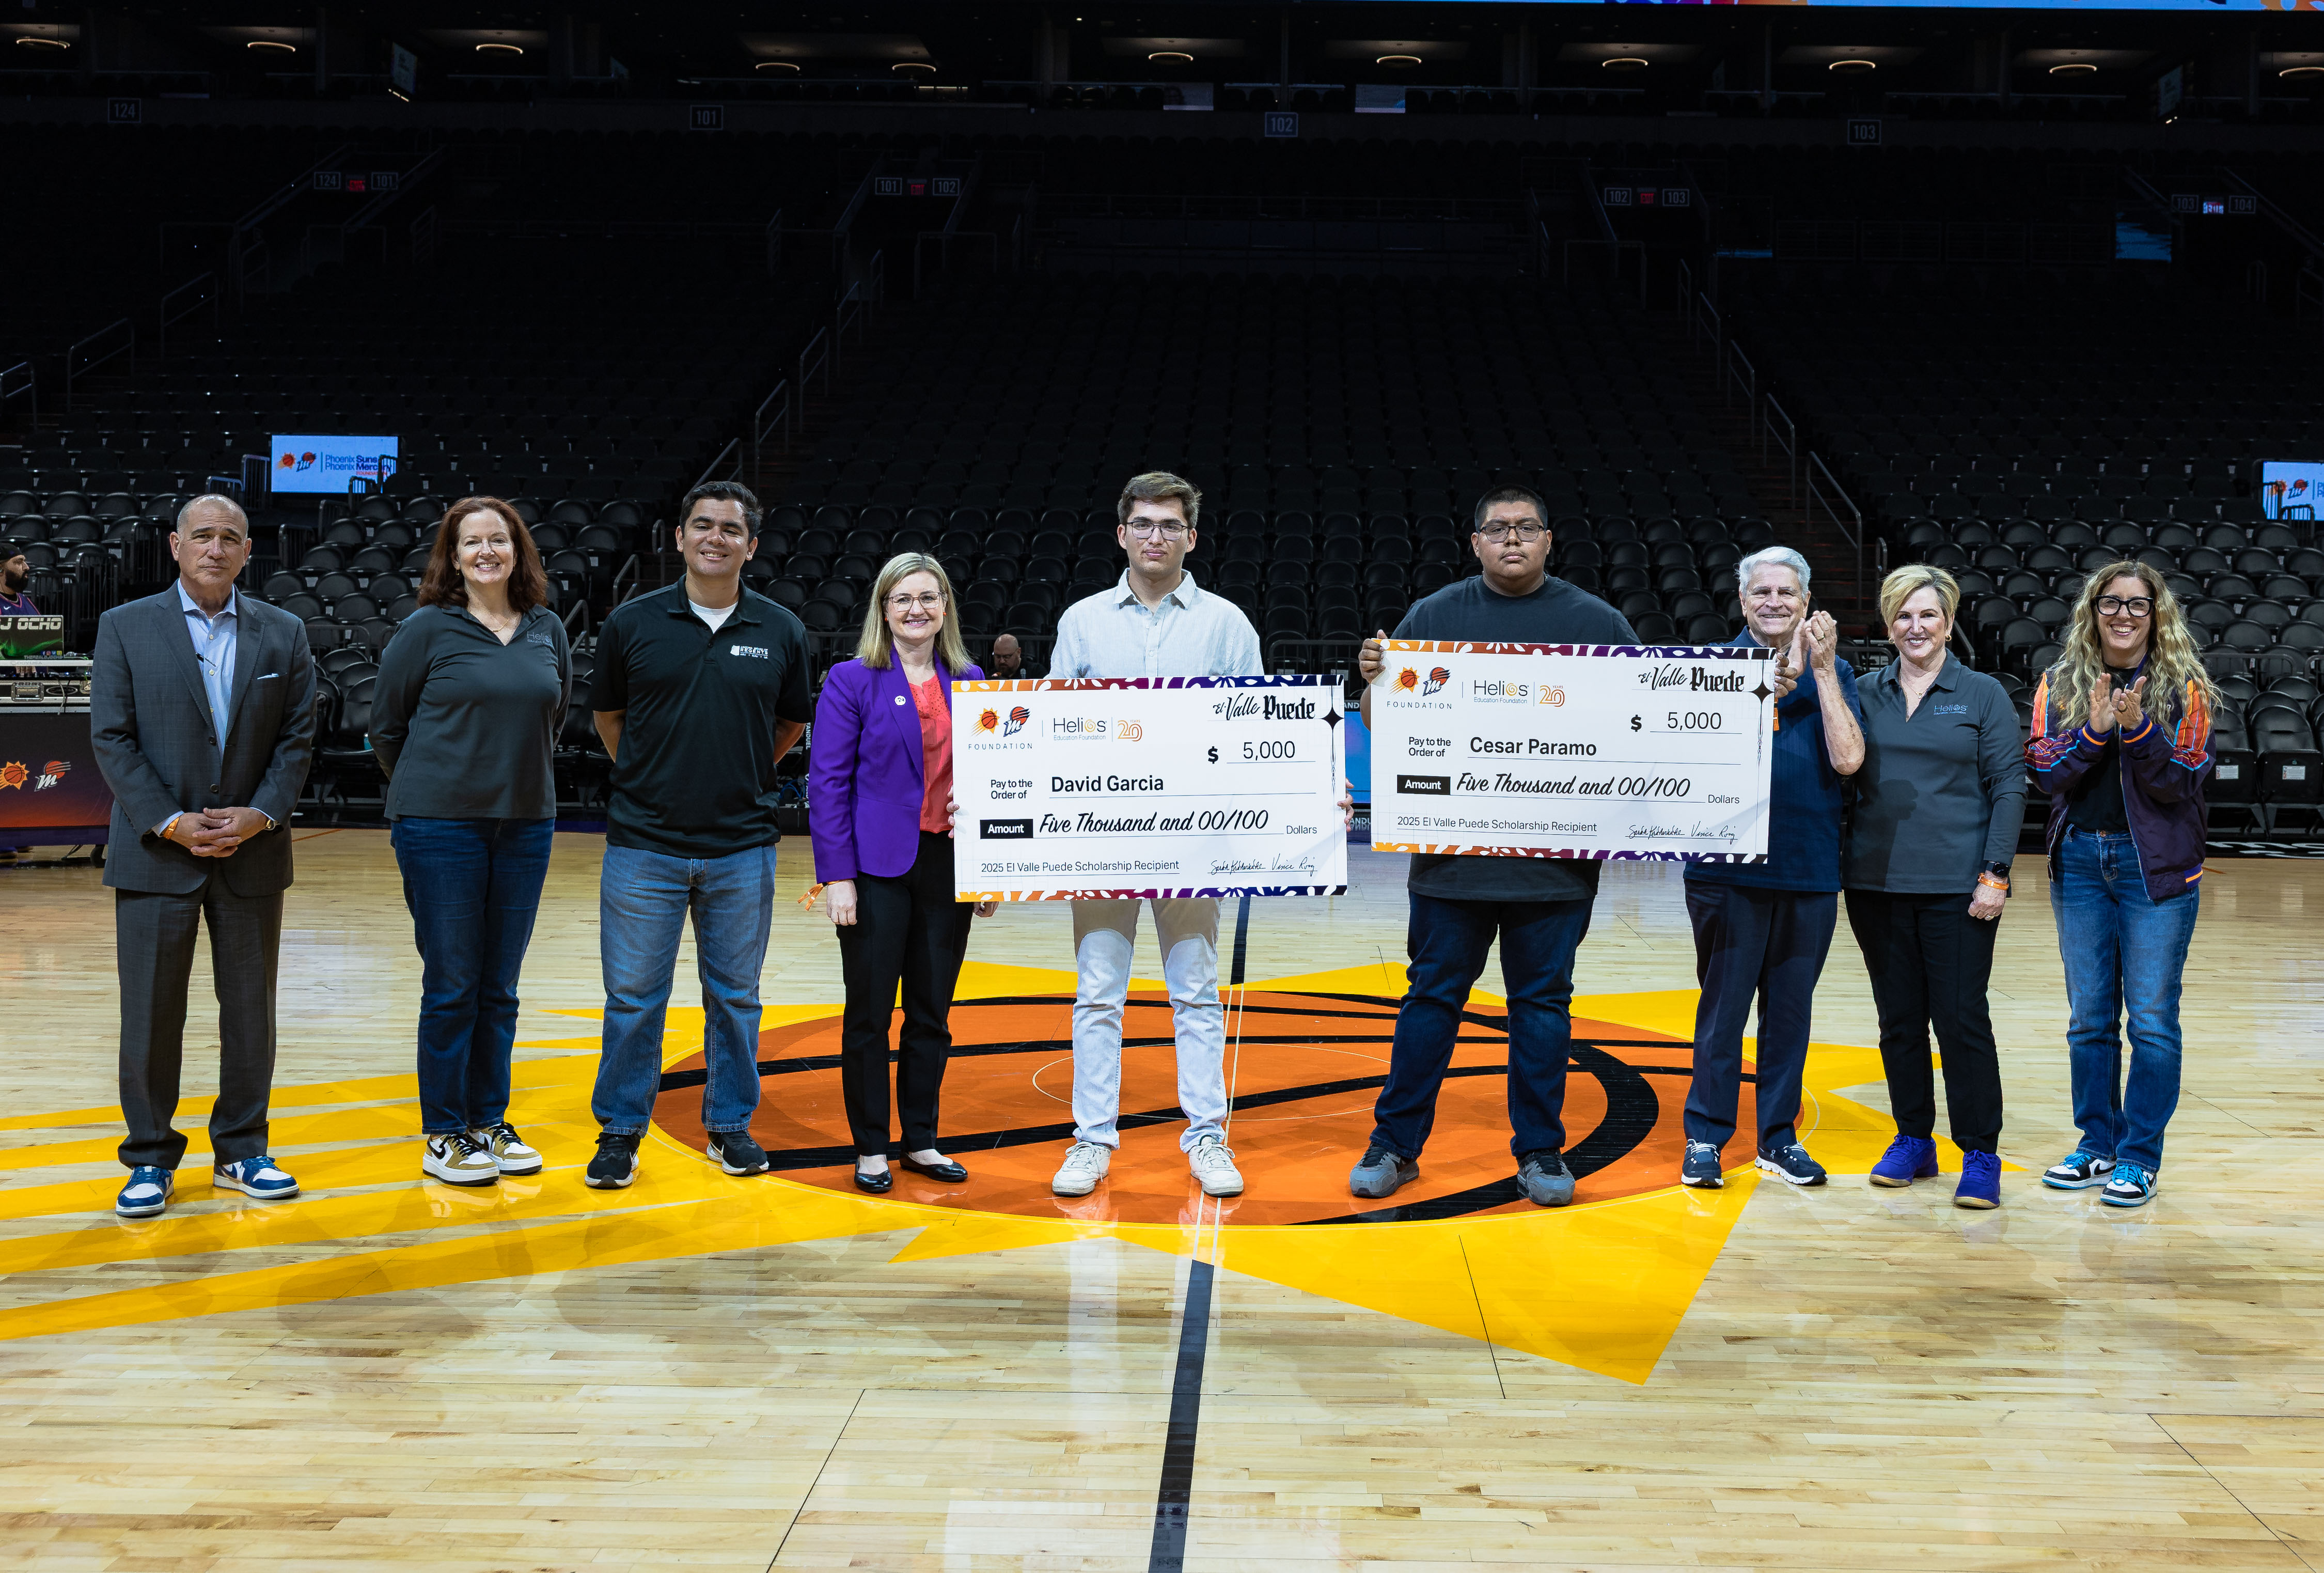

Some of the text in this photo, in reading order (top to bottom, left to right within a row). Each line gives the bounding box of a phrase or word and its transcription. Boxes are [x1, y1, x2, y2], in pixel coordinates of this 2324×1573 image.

[114, 103, 136, 118] 124
[696, 110, 716, 125] 101
[1271, 117, 1293, 132] 102
[1854, 124, 1876, 140] 103
[319, 175, 336, 186] 124
[377, 175, 393, 187] 101
[881, 180, 897, 192] 101
[938, 181, 956, 193] 102
[1610, 191, 1628, 203] 102
[1668, 192, 1686, 204] 103
[2177, 198, 2195, 210] 103
[2235, 198, 2251, 210] 104
[325, 455, 355, 463] Phoenix
[356, 462, 392, 472] Mercry
[0, 618, 61, 630] J OCHO
[1652, 663, 1688, 690] Valle
[1689, 666, 1745, 692] Puede
[1474, 680, 1528, 696] Helios
[1539, 685, 1565, 707] 20
[1226, 693, 1261, 721] Valle
[1263, 695, 1315, 720] Puede
[1054, 718, 1106, 733] Helios
[1631, 712, 1721, 732] $ 5,000
[1117, 720, 1142, 741] 20
[1409, 737, 1425, 747] Pay
[1437, 738, 1451, 746] the
[1470, 737, 1597, 756] Cesar Paramo
[1207, 741, 1295, 764] $ 5,000
[1409, 747, 1445, 757] Order of
[991, 780, 1006, 790] Pay
[1018, 778, 1033, 788] the
[1051, 775, 1164, 792] David Garcia
[1405, 780, 1441, 790] Amount
[1456, 772, 1690, 797] Five Thousand and 00/100
[991, 790, 1027, 799] Order of
[1708, 795, 1740, 804] Dollars
[1039, 809, 1268, 833] Five Thousand and 00/100
[1397, 816, 1597, 833] 2025 El Valle Puede Scholarship Recipient
[987, 824, 1024, 834] Amount
[1286, 825, 1317, 834] Dollars
[981, 860, 1180, 872] 2025 El Valle Puede Scholarship Recipient
